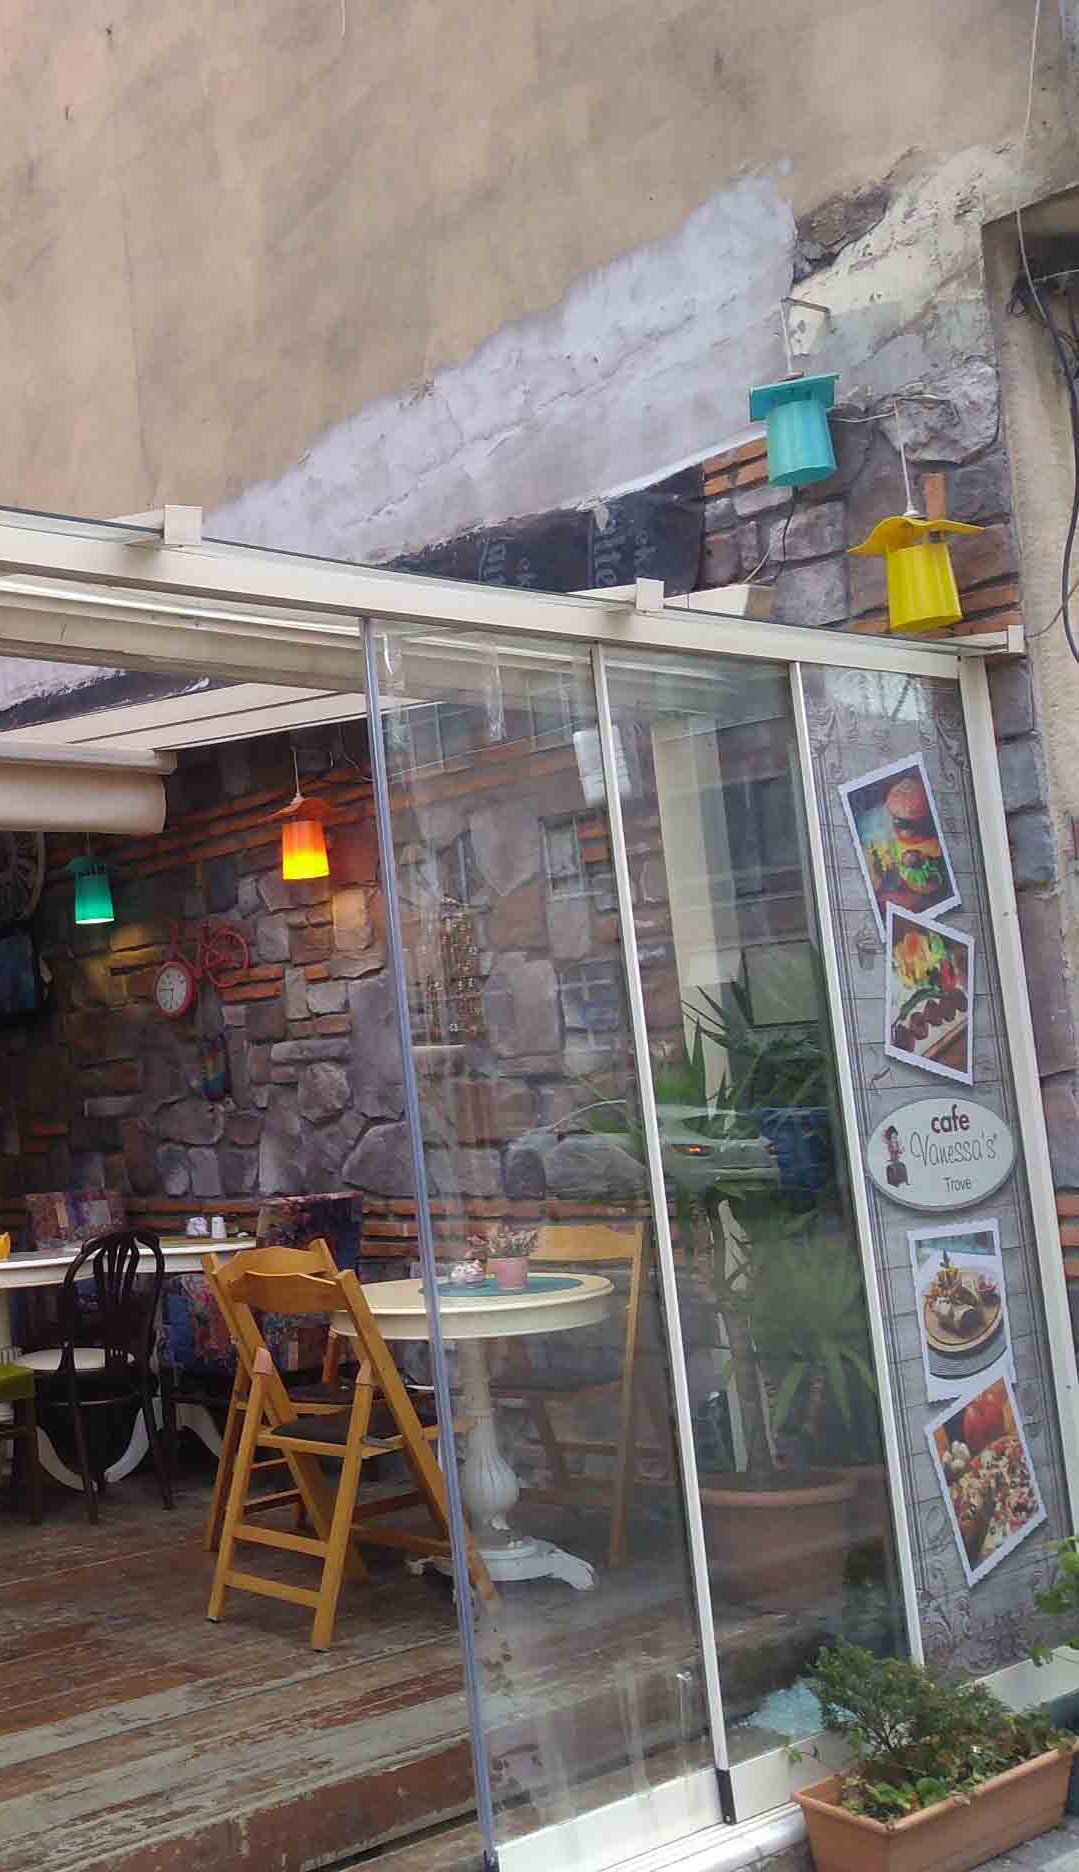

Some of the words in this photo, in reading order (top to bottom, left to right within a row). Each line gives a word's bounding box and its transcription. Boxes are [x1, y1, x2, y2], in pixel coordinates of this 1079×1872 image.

[931, 1104, 970, 1133] cafe
[910, 1131, 997, 1167] Vanessa's
[943, 1177, 971, 1192] Trove
